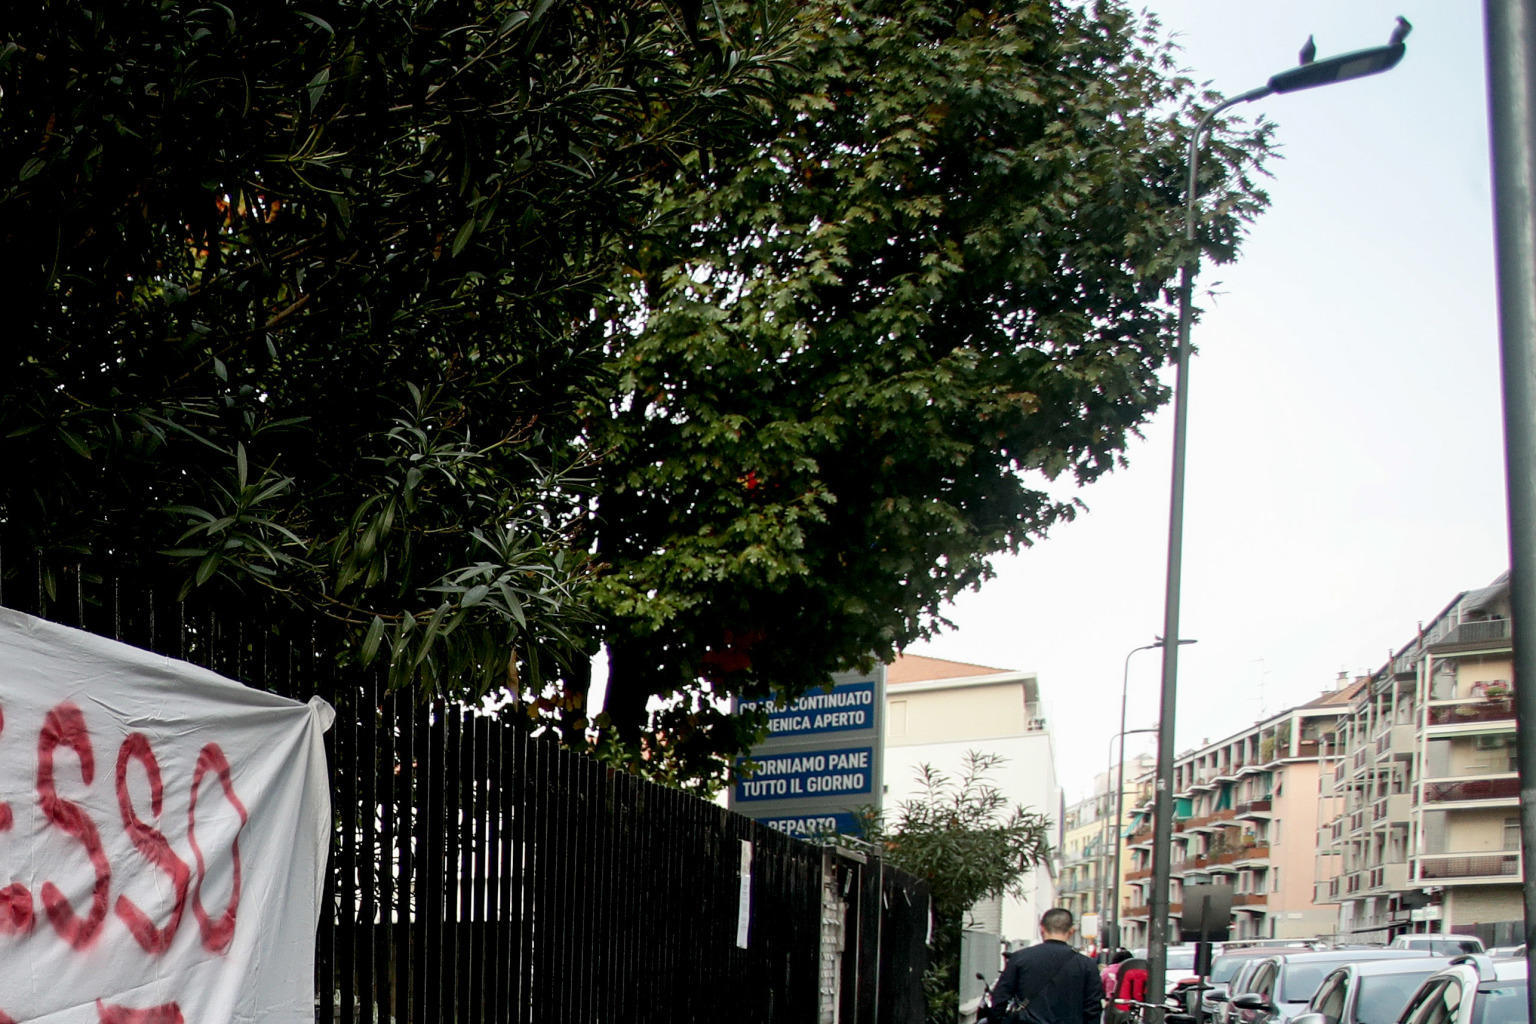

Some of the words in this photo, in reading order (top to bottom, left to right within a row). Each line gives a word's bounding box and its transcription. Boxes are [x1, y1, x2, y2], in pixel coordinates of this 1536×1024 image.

[739, 699, 787, 715] ORRIO
[814, 711, 865, 729] APERTO
[743, 756, 825, 776] ORNIAMO
[829, 751, 868, 771] PANE
[742, 779, 787, 797] TUTTO
[790, 777, 804, 794] IL
[806, 773, 864, 793] GIORNO
